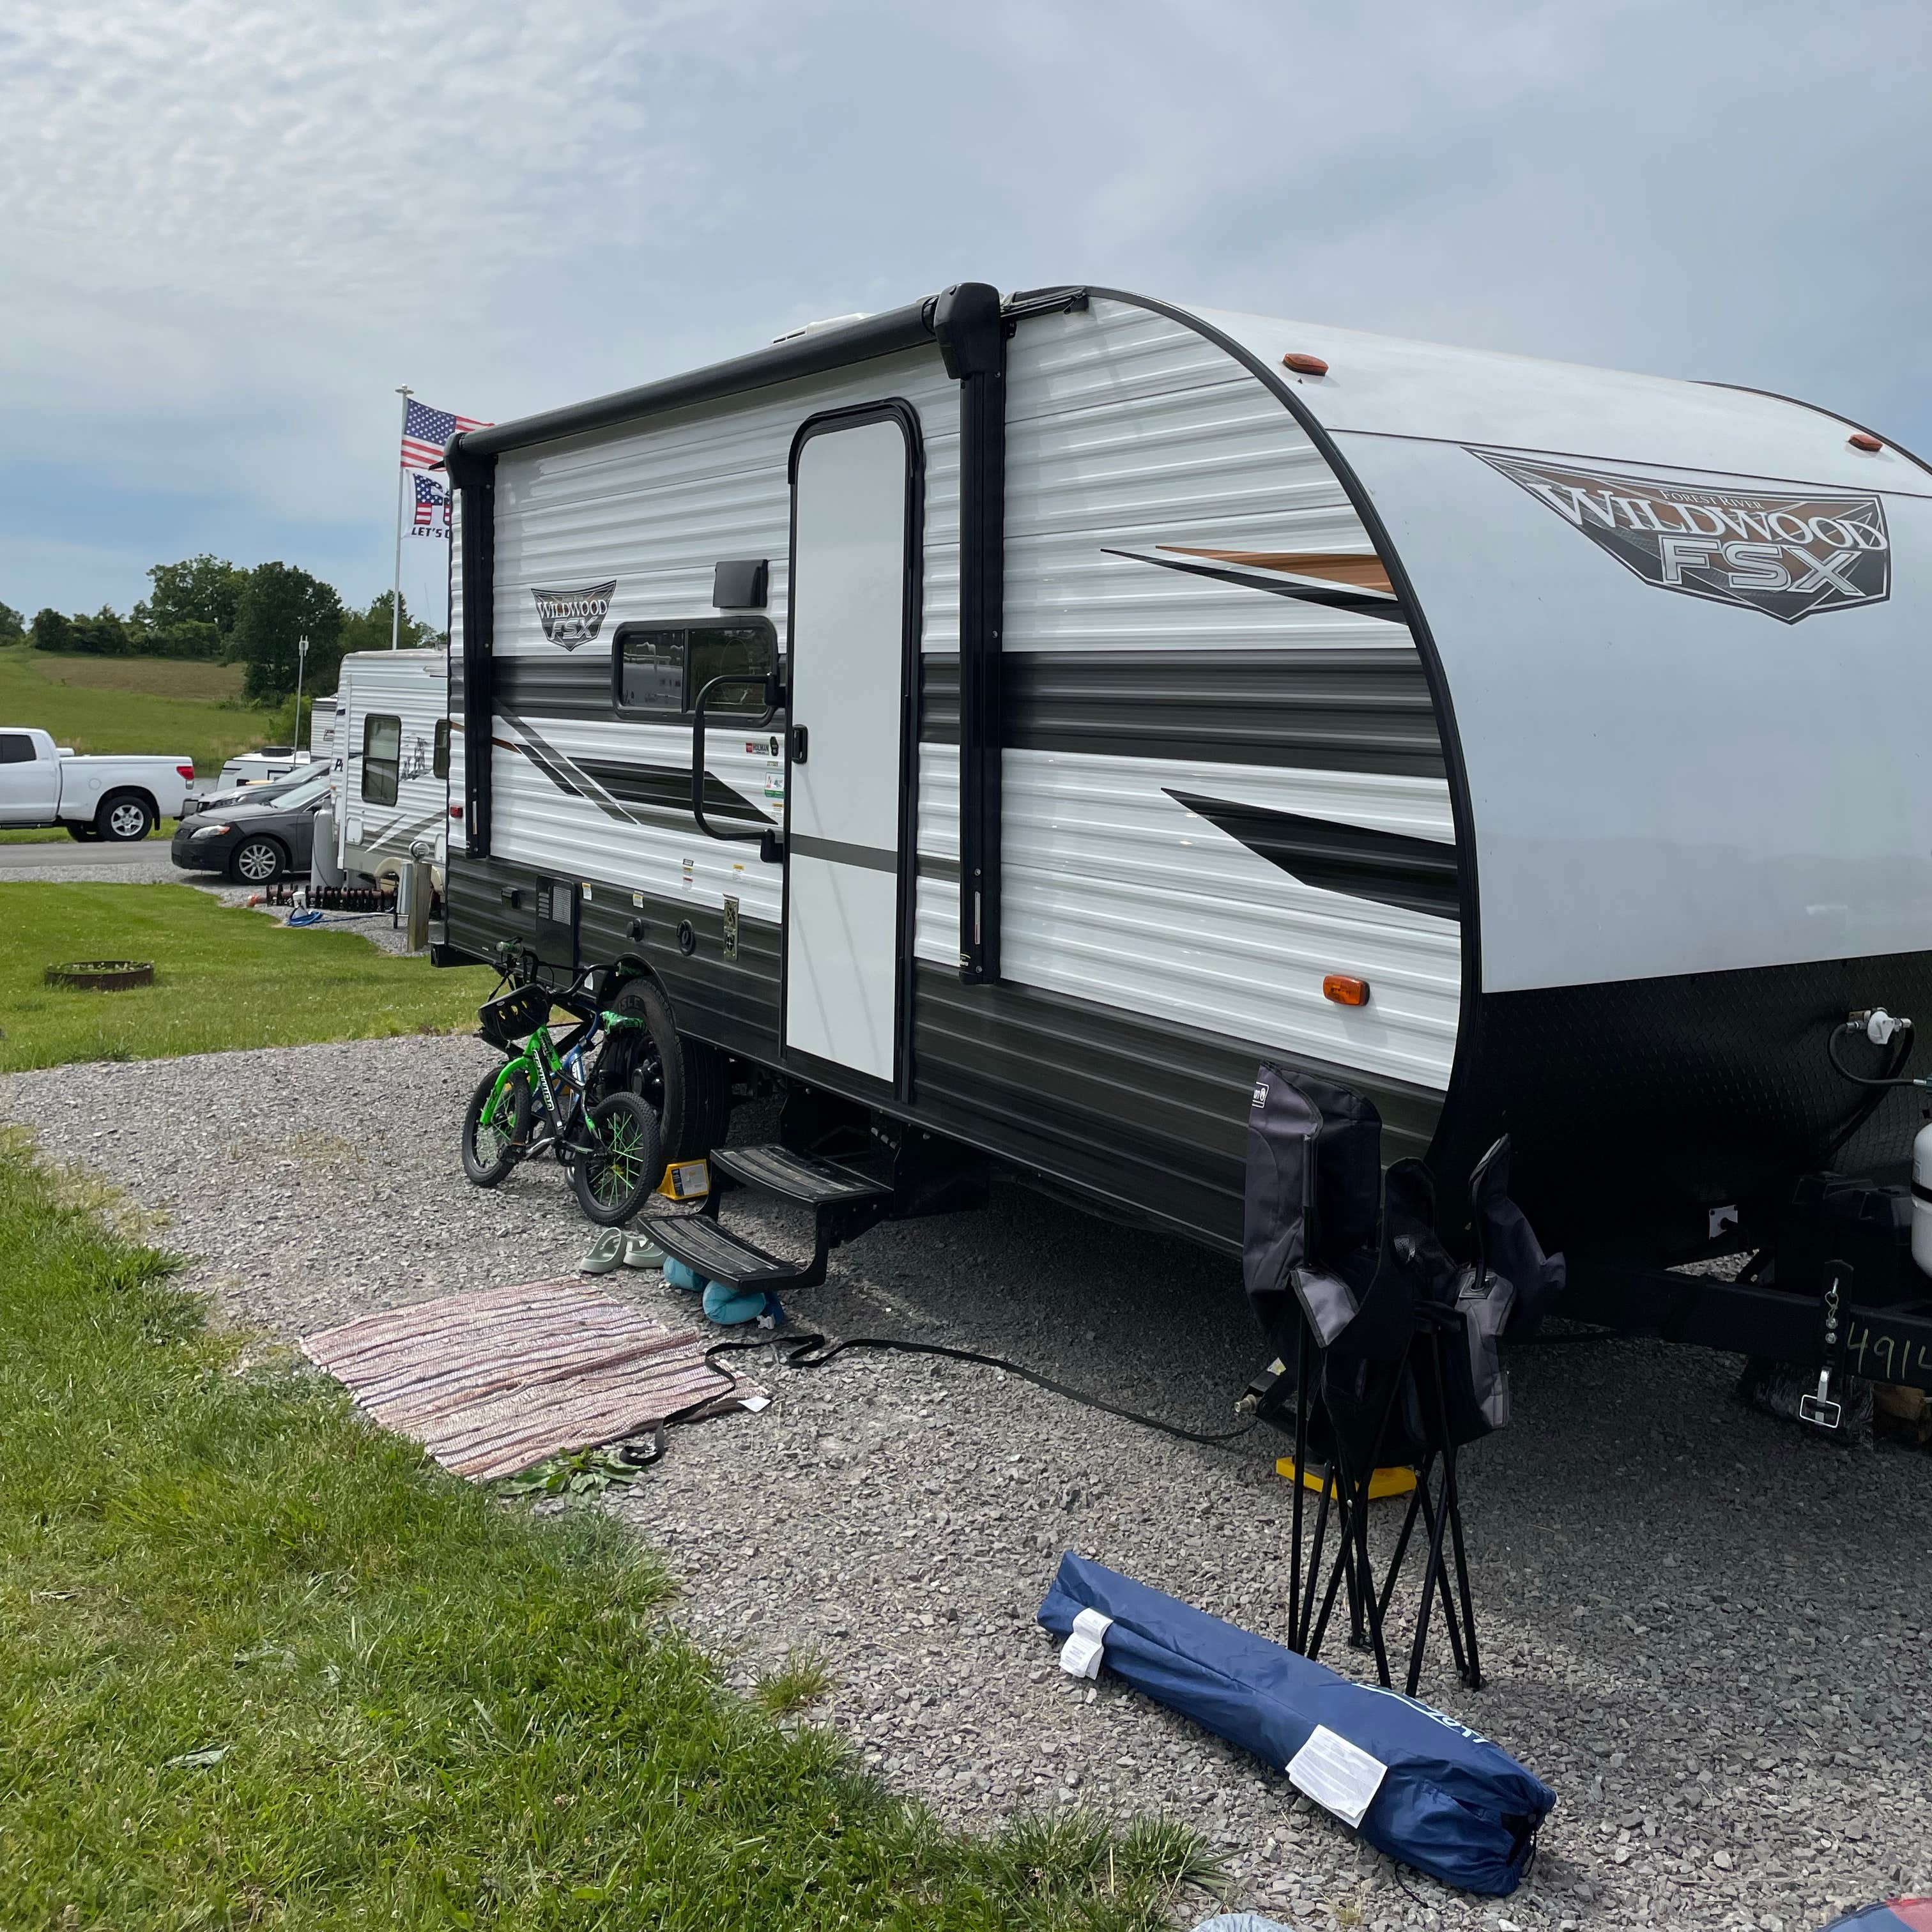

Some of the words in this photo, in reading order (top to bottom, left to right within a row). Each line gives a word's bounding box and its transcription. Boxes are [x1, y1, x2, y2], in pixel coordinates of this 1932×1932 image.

[1659, 489, 1717, 505] FOREST
[1718, 496, 1766, 510] RIVER
[1528, 483, 1889, 550] WILDWOOD
[411, 526, 442, 536] LET'S
[1658, 535, 1867, 597] FSX
[537, 599, 608, 619] WILDWOOD
[550, 616, 599, 640] FSX
